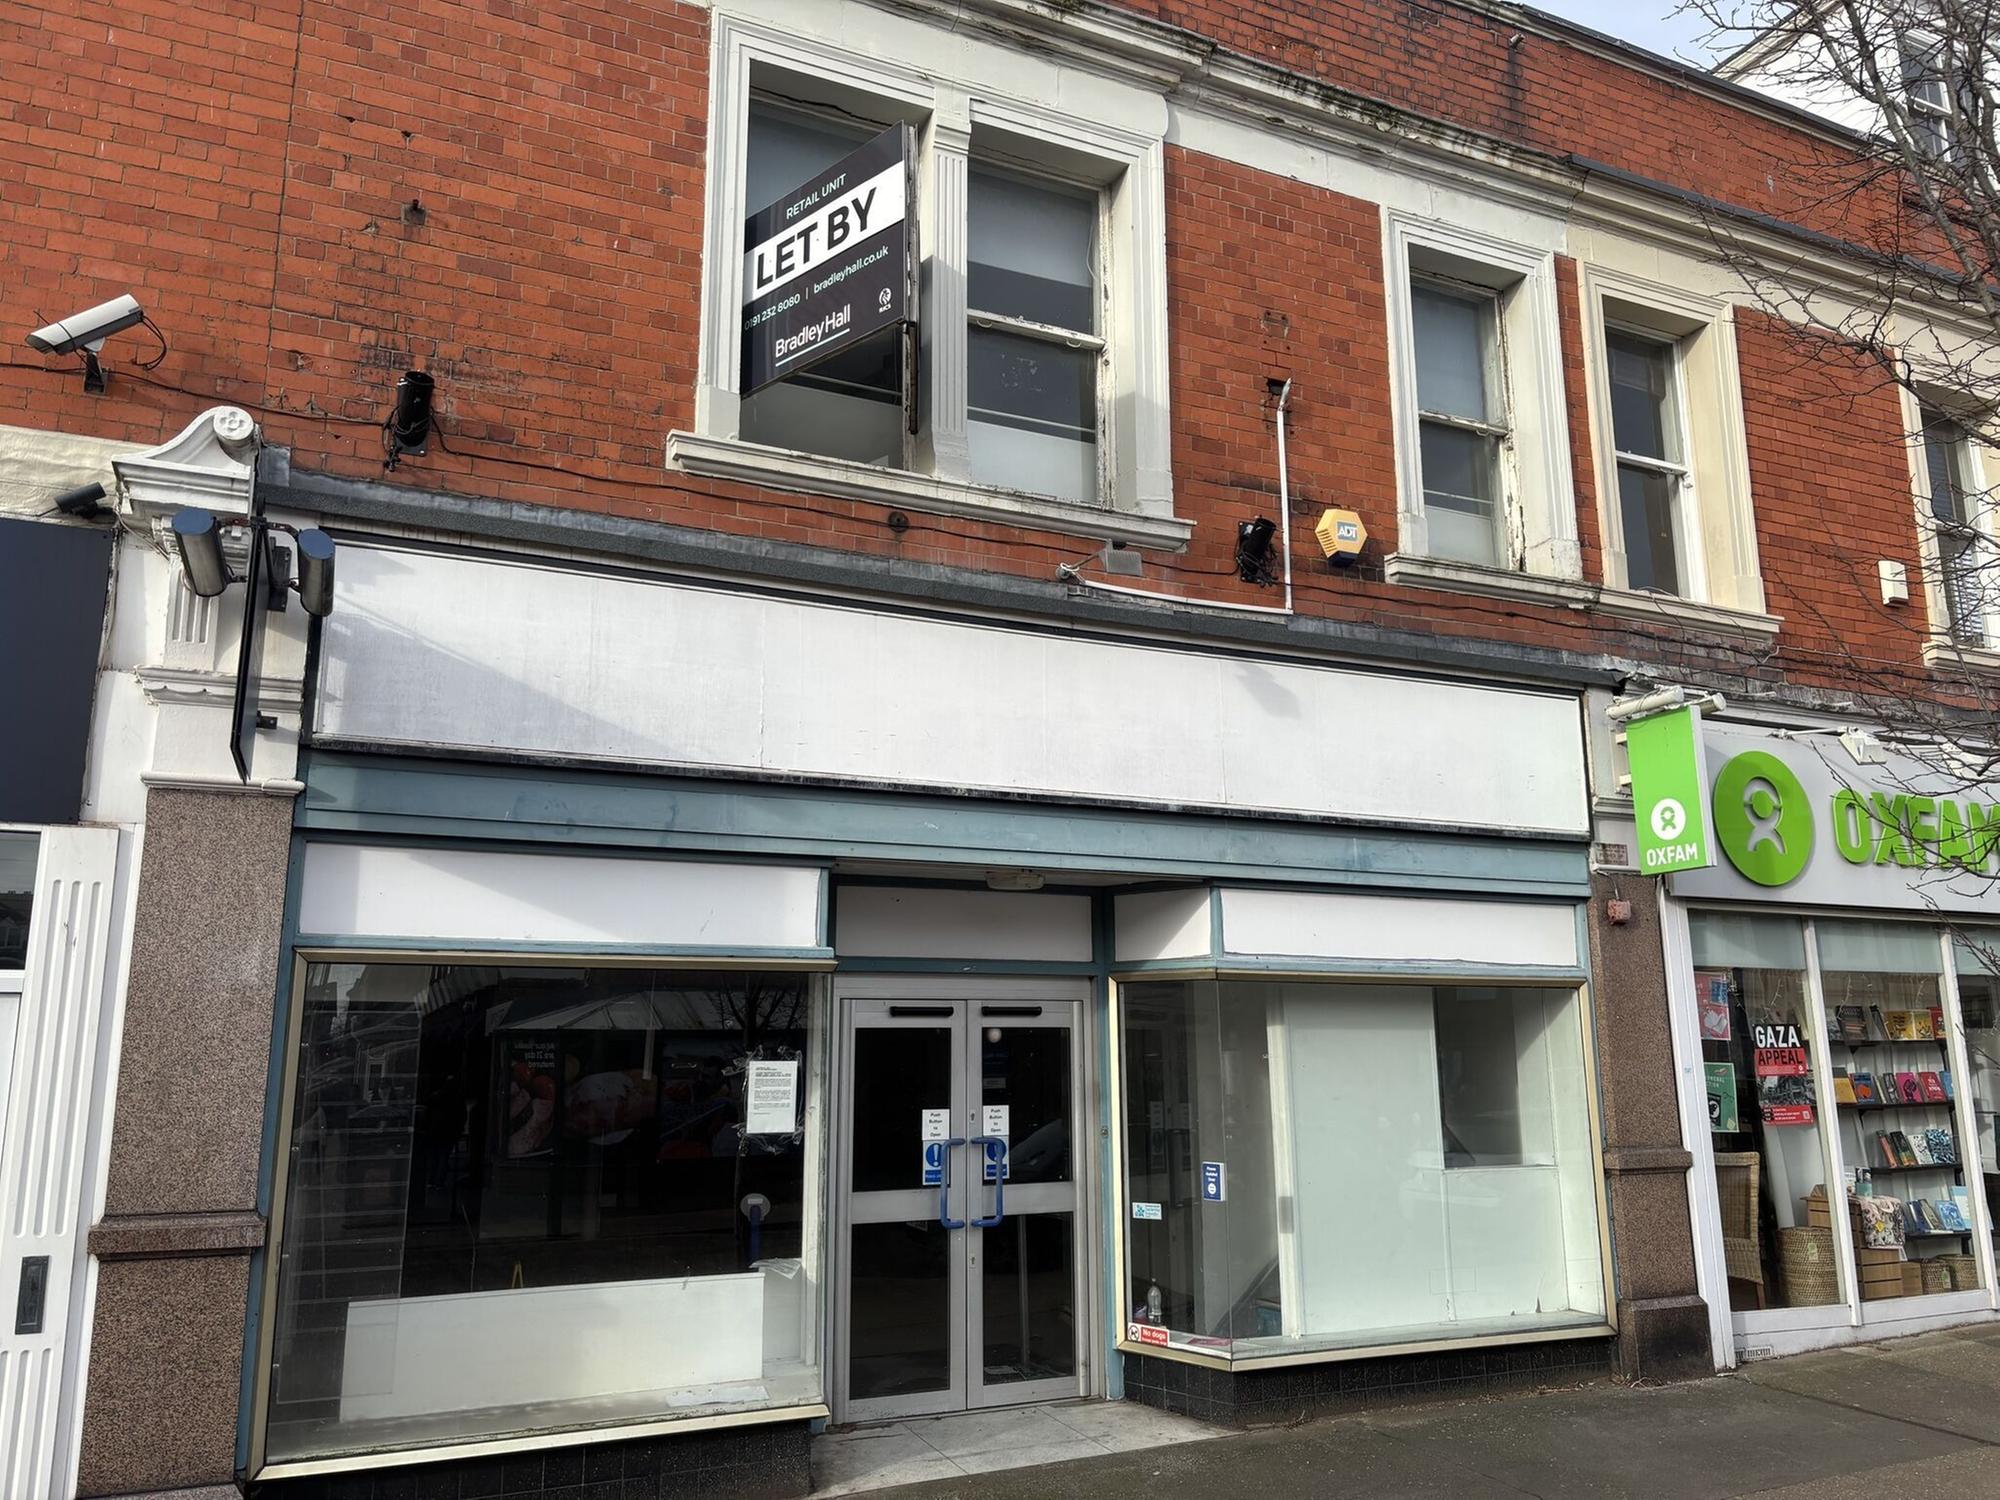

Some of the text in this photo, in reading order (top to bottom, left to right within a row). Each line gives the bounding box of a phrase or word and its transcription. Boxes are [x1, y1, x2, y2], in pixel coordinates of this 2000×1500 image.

[786, 173, 847, 220] RETAIL UNIT
[756, 187, 878, 290] LET BY
[744, 245, 889, 331] 0191 232 8080 bradleyhall.co.uk
[1339, 525, 1358, 538] ADT
[1832, 788, 2000, 873] OXFAM
[1646, 842, 1699, 867] OXFAM
[1755, 1025, 1801, 1049] GAZA
[1758, 1049, 1803, 1066] APPEAL
[1142, 1328, 1166, 1340] No dogs
